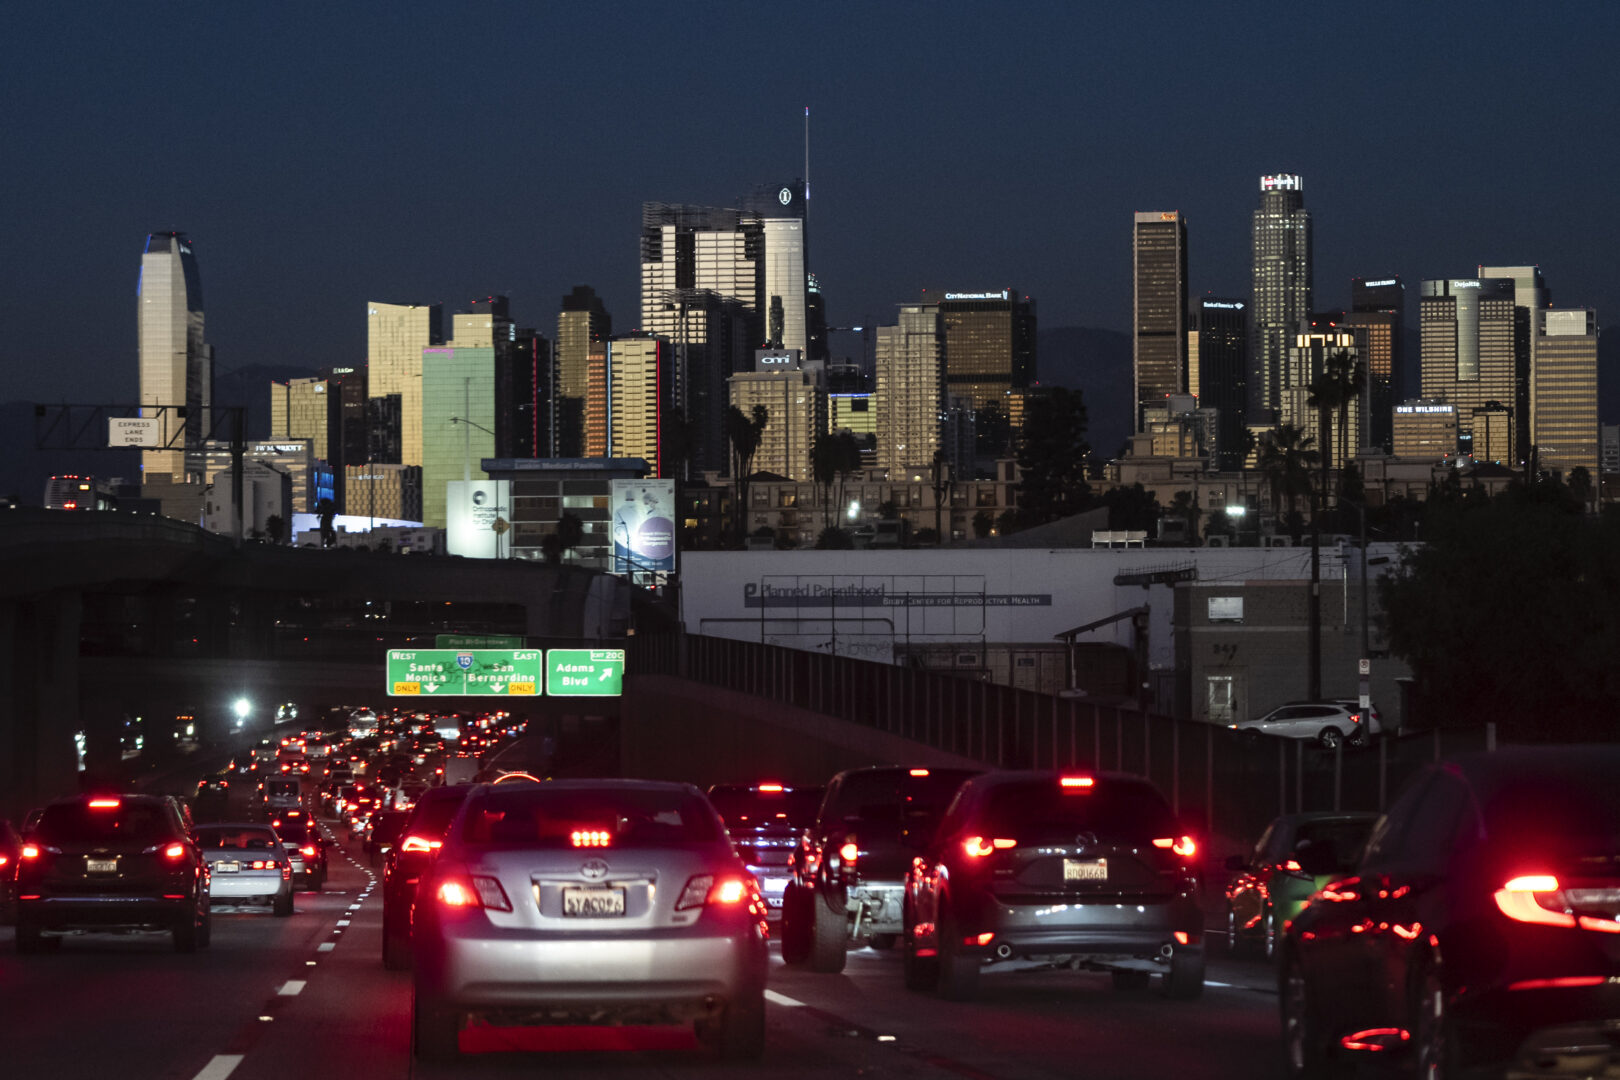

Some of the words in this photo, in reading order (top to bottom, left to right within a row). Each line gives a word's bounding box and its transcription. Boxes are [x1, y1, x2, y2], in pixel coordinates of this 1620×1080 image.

[760, 584, 809, 597] Planned
[813, 583, 885, 598] Parenthood
[392, 652, 416, 660] WEST
[513, 652, 538, 660] EAST
[460, 657, 471, 665] 10
[409, 663, 443, 672] Santa
[493, 663, 514, 672] San
[556, 663, 595, 673] Adams
[405, 673, 447, 682] Monica
[468, 673, 536, 682] Bernardino
[562, 676, 589, 686] Blvd
